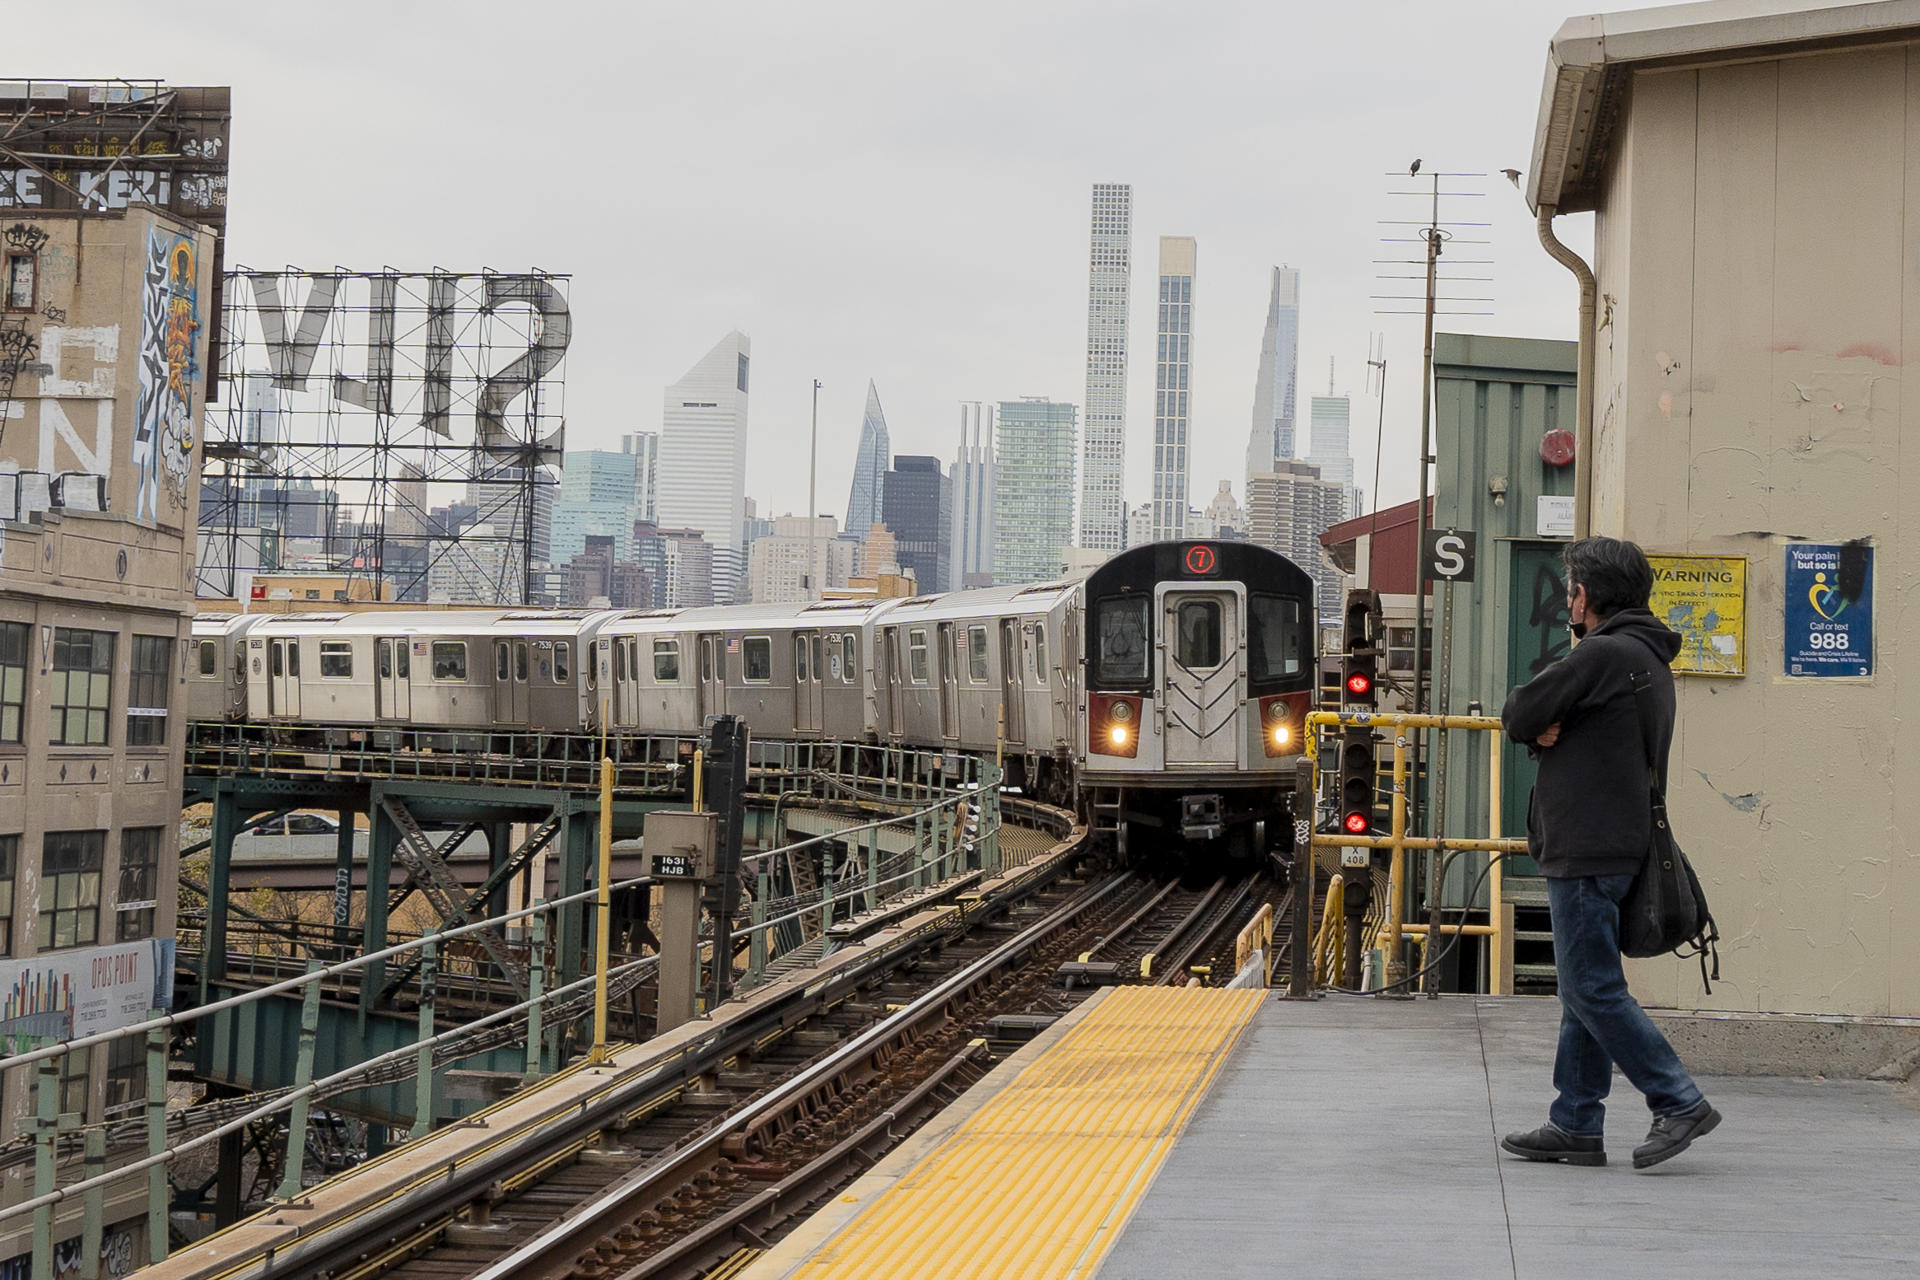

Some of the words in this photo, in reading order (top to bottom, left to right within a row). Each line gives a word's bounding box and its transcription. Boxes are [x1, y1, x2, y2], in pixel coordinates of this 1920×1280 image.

[1195, 551, 1206, 568] 7
[1434, 535, 1466, 576] S
[1792, 550, 1815, 560] Your
[1815, 551, 1836, 561] pain
[1797, 560, 1814, 569] but
[1827, 560, 1837, 569] is
[1809, 622, 1824, 630] Call
[1809, 632, 1849, 649] 988
[1352, 846, 1359, 854] X
[662, 856, 685, 865] 1631
[1346, 856, 1364, 864] 408
[661, 866, 684, 875] HJB
[91, 956, 112, 989] OPUS
[114, 952, 139, 985] POINT
